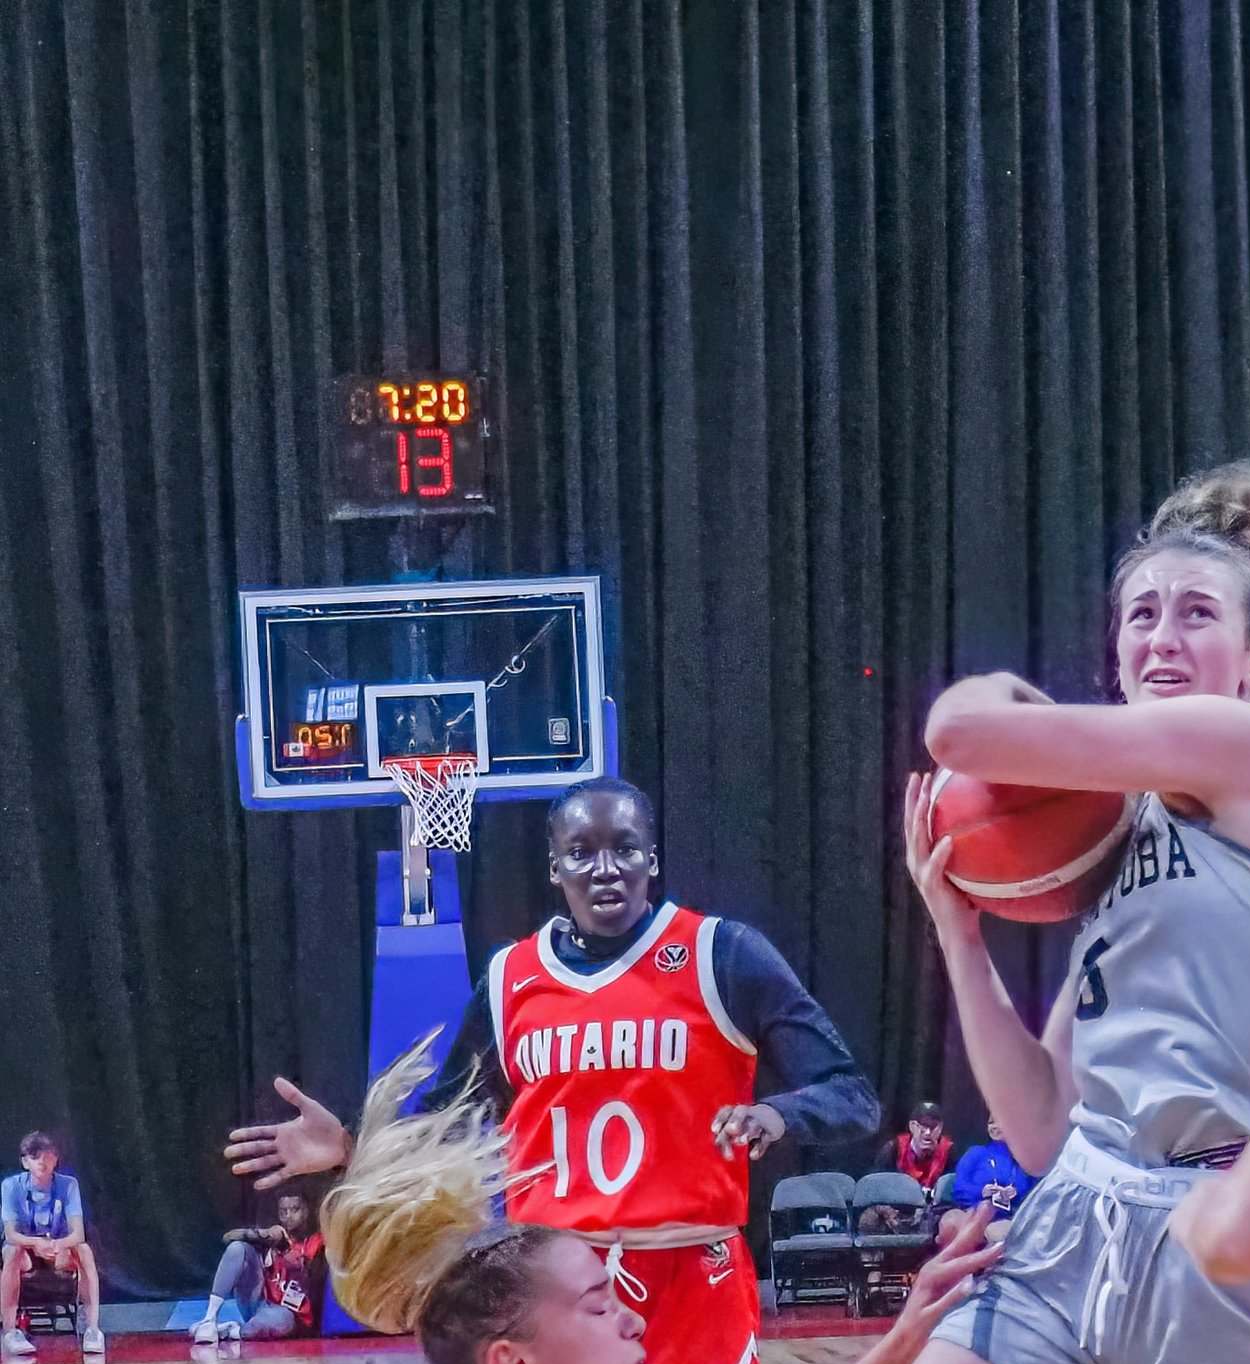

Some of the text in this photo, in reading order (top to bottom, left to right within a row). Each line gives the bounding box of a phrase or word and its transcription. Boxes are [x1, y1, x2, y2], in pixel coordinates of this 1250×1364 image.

[379, 383, 466, 422] 7:20
[398, 428, 452, 496] 13
[515, 1018, 688, 1084] ONTARIO
[550, 1100, 645, 1198] 10
